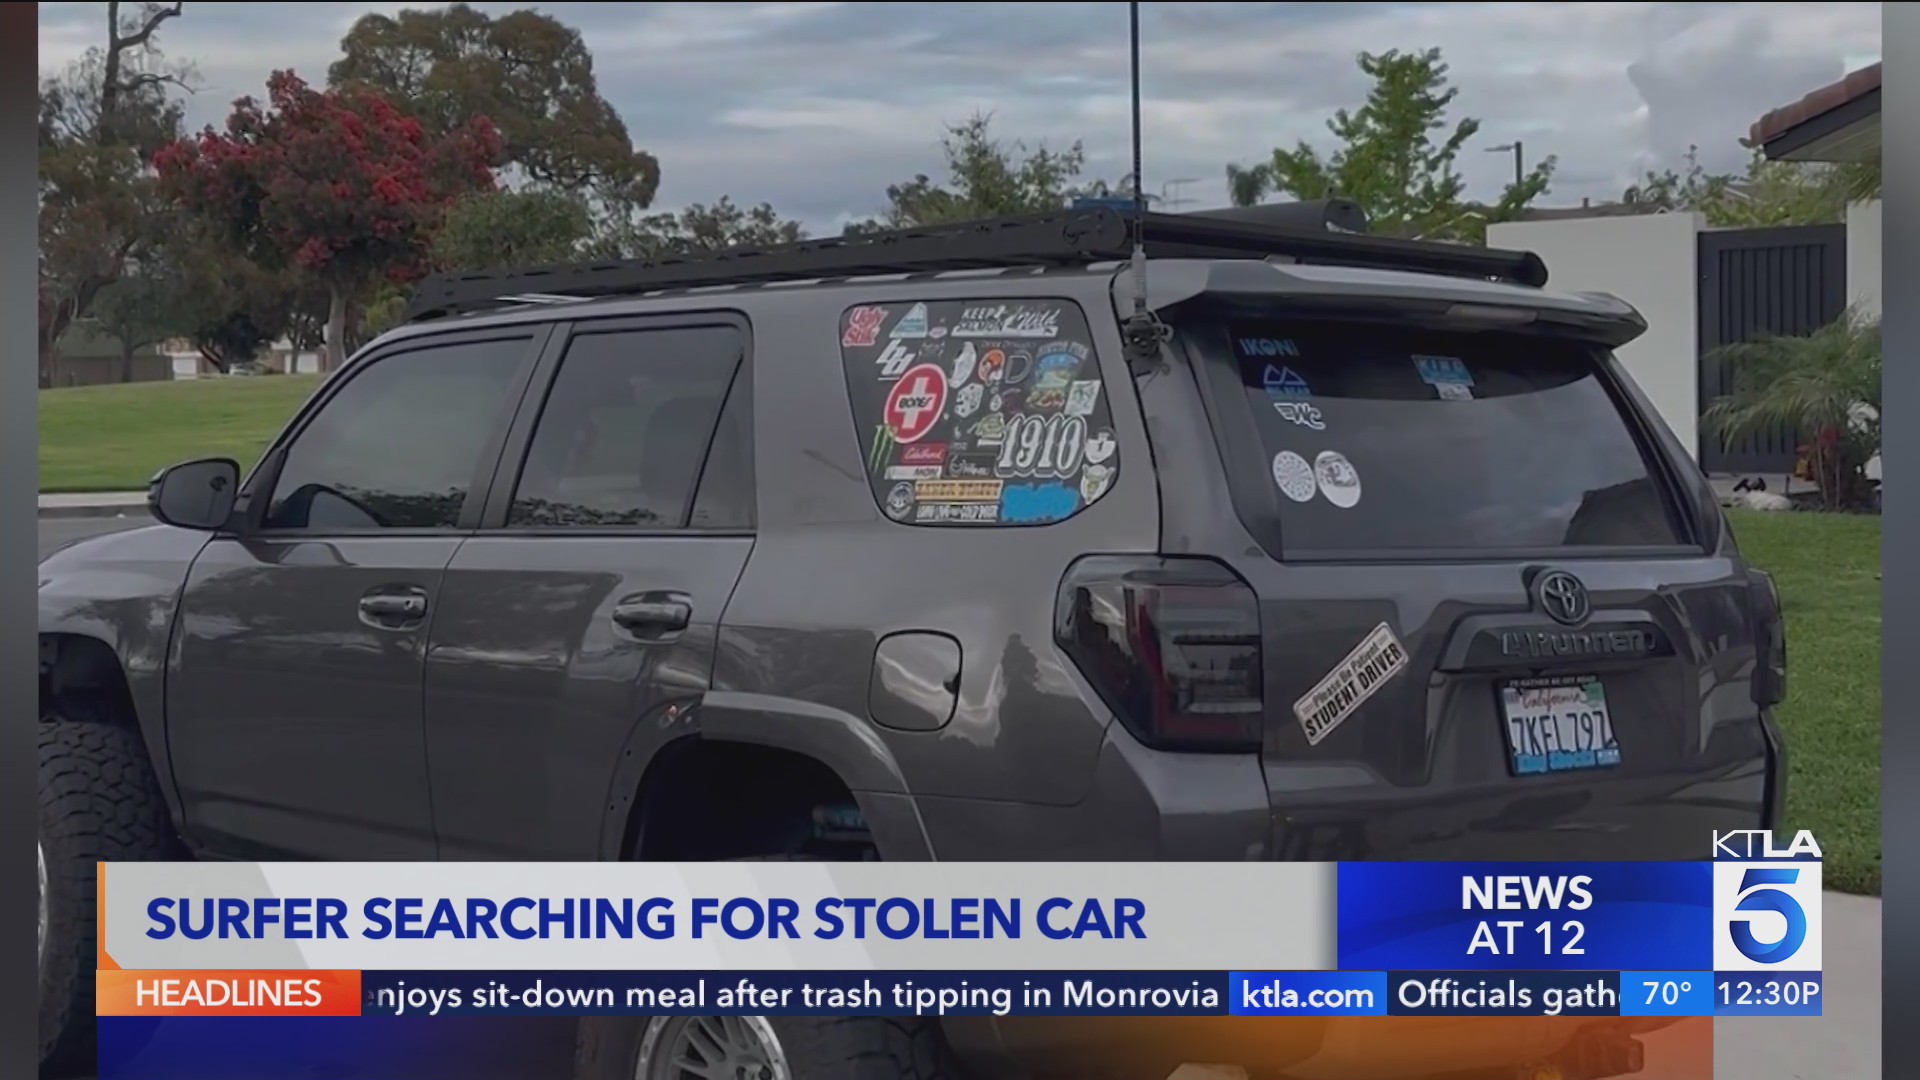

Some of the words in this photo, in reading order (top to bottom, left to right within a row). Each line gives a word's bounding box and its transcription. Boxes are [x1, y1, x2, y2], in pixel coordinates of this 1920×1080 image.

[998, 414, 1083, 472] 1910
[1305, 681, 1358, 737] STUDENT
[1357, 642, 1402, 690] DRIVER
[1522, 689, 1580, 712] California
